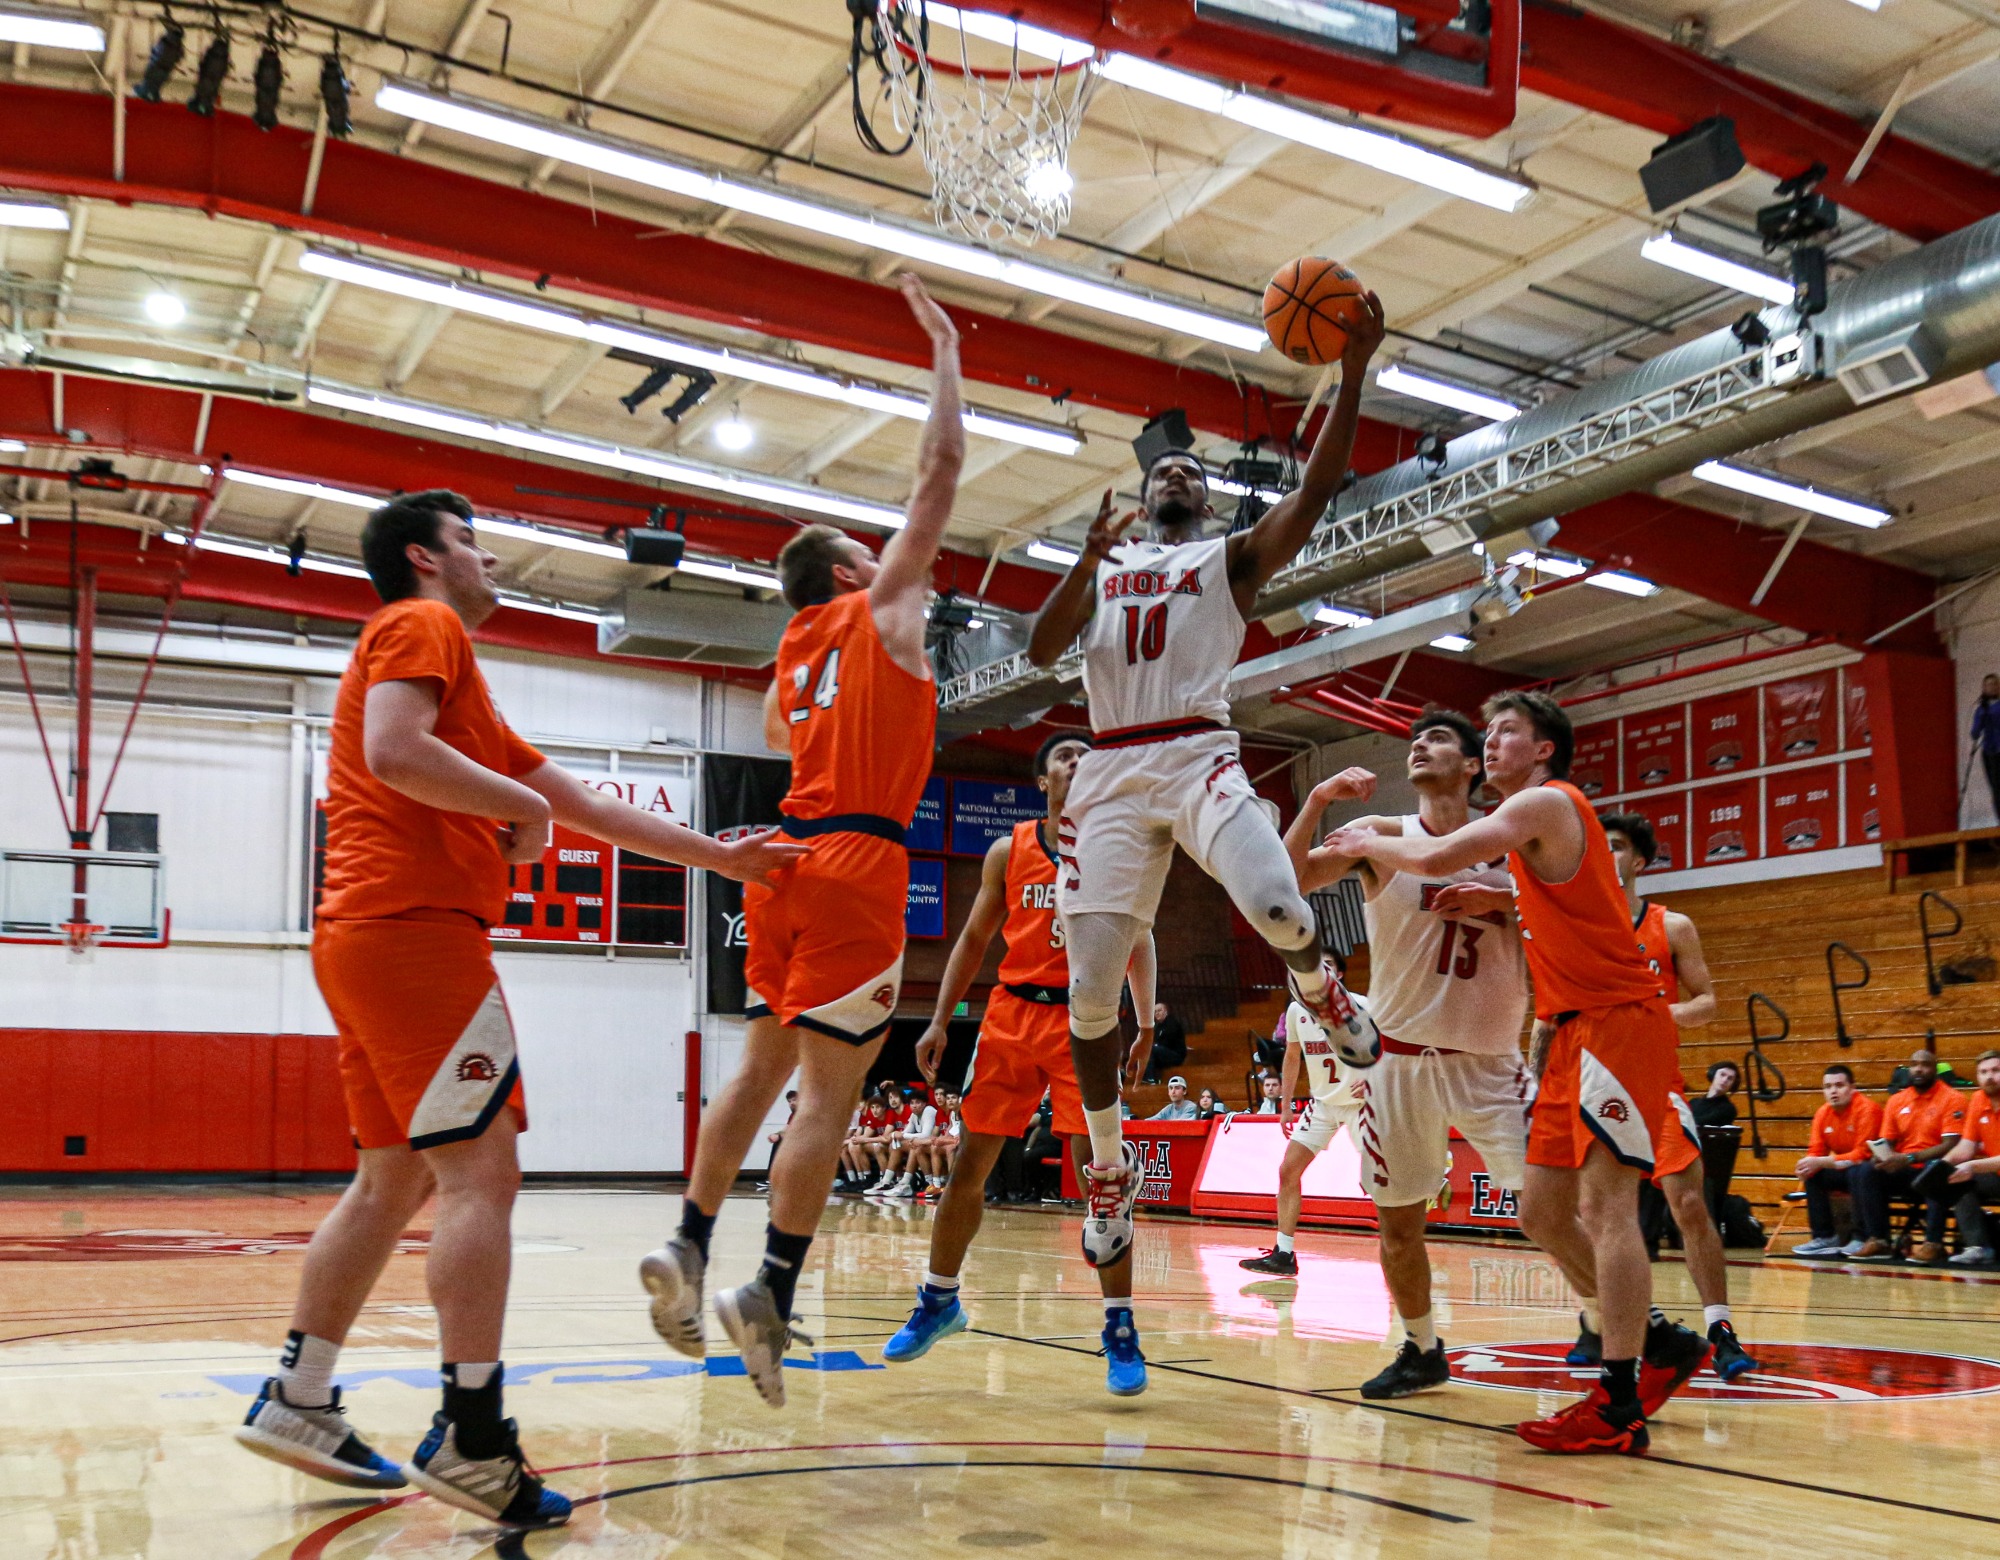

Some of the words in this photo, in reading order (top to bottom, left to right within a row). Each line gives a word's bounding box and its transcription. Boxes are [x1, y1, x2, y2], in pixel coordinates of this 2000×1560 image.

[1104, 567, 1203, 600] BIOLA
[1122, 602, 1168, 666] 10
[789, 647, 841, 725] 24
[955, 814, 990, 825] WOMEN'S
[959, 803, 999, 815] NATIONAL
[558, 848, 600, 864] GUEST
[512, 892, 536, 903] FOUL
[575, 896, 604, 906] FOULS
[1437, 919, 1484, 980] 13
[1323, 1058, 1341, 1084] 2
[1470, 1172, 1519, 1218] EA
